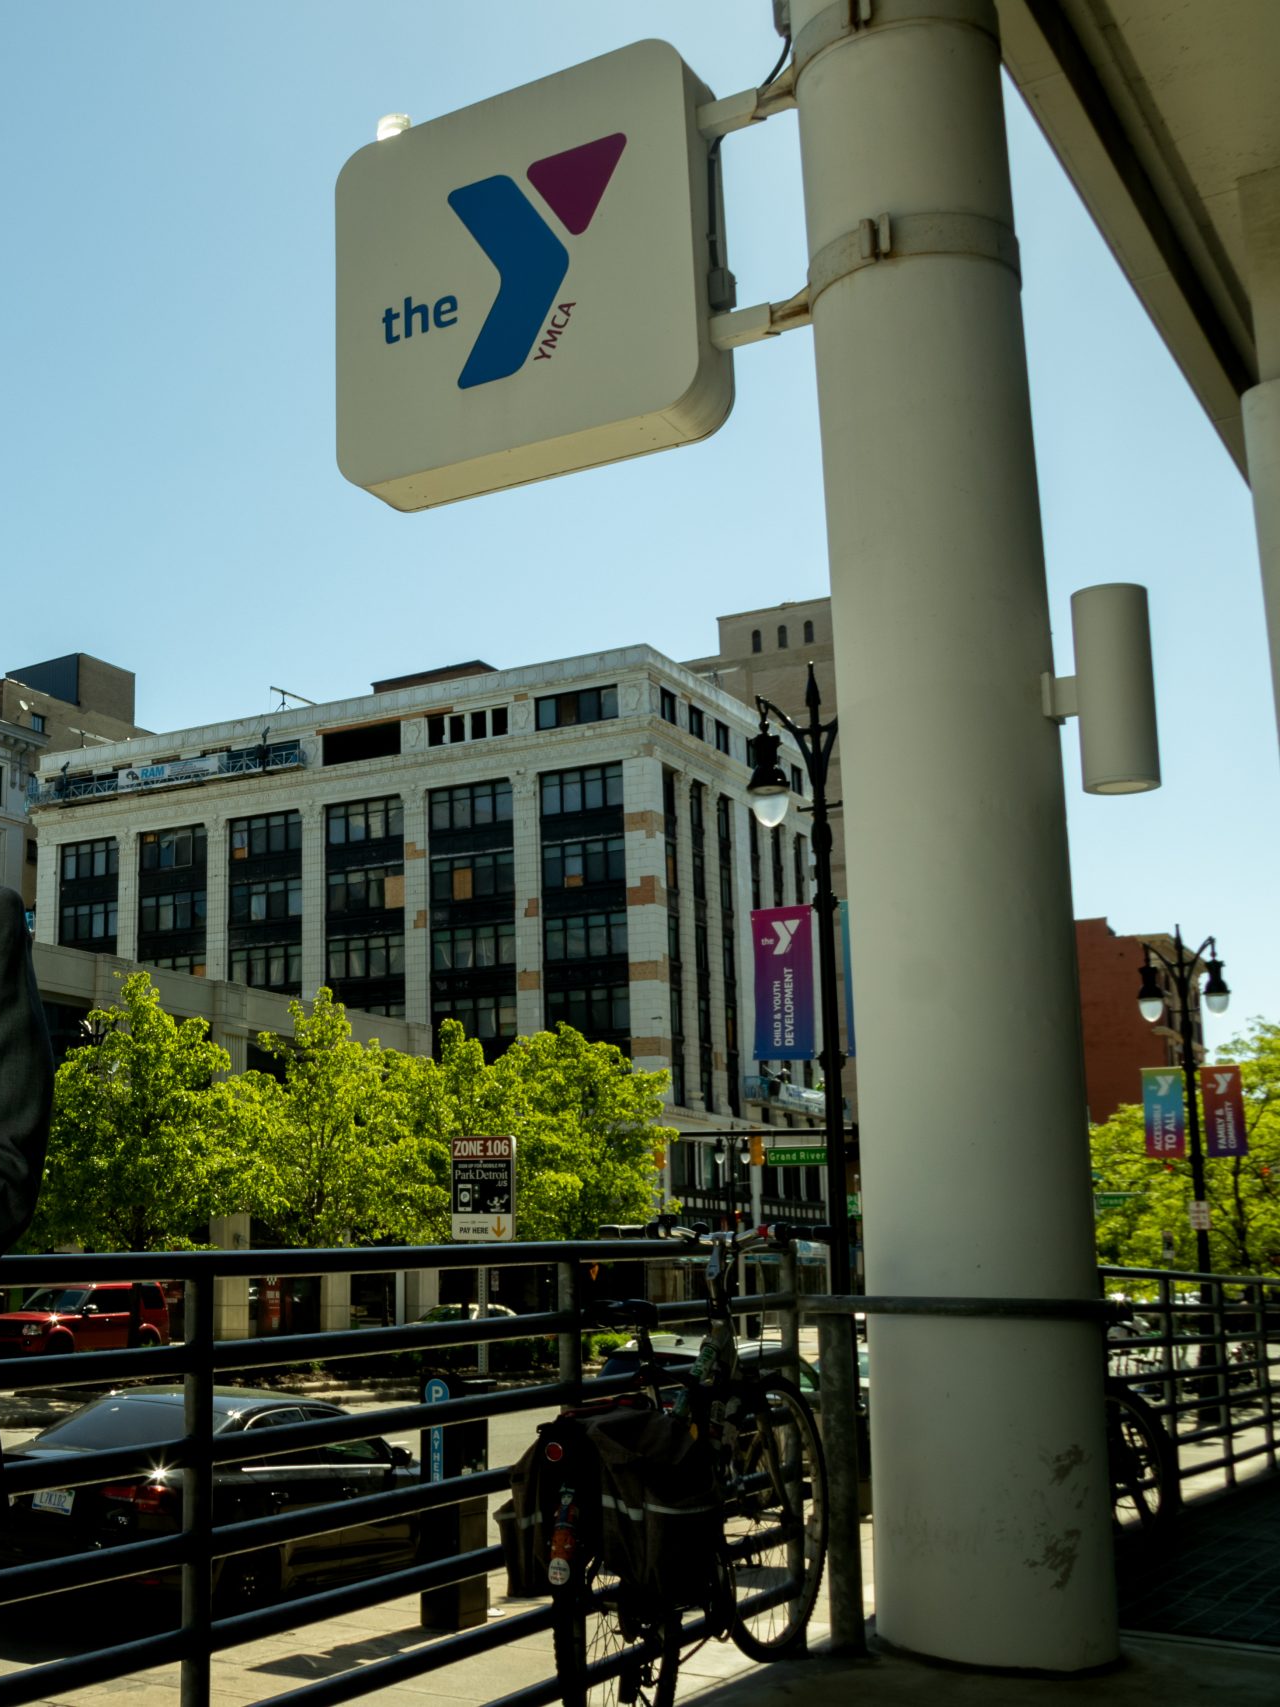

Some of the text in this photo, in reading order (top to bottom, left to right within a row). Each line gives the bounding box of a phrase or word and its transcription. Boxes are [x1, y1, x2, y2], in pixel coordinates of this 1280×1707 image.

[381, 295, 458, 345] the
[533, 301, 577, 362] YMCA
[140, 766, 165, 779] RAM
[773, 980, 781, 1012] YOUTH
[783, 967, 795, 1047] DEVELOPMENT
[773, 1021, 782, 1047] CHILD
[1152, 1104, 1163, 1151] ACCESSIBLE
[1164, 1110, 1178, 1151] TO ALL
[1215, 1118, 1225, 1150] FAMILY
[1224, 1101, 1237, 1149] COMMUNITY
[454, 1139, 510, 1156] ZONE 106
[769, 1151, 826, 1161] Grand River
[459, 1226, 489, 1235] PAY HERE
[431, 1385, 443, 1403] P
[432, 1430, 440, 1450] AY
